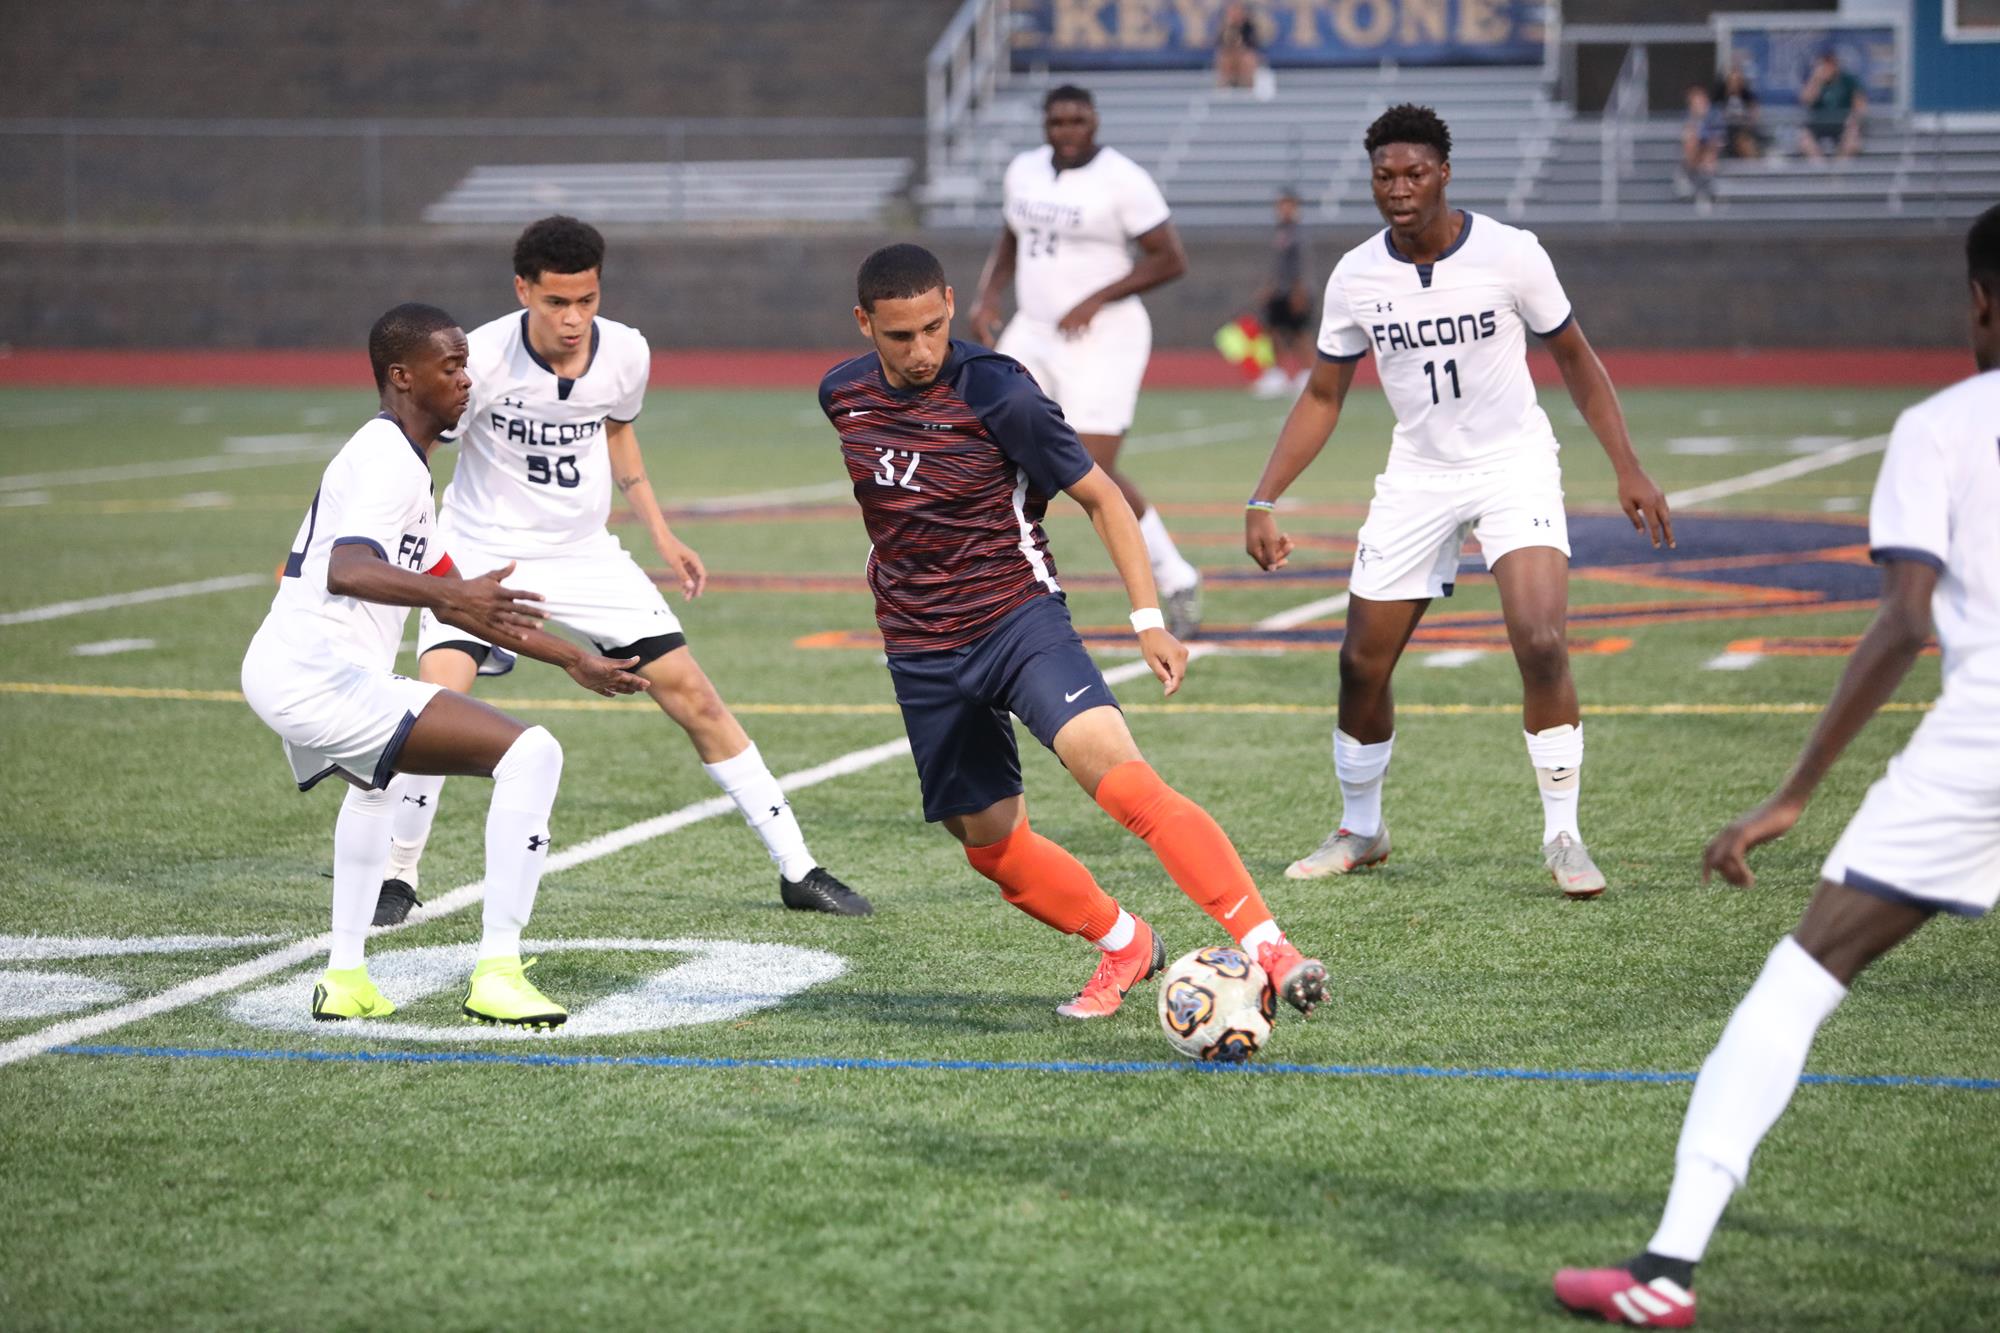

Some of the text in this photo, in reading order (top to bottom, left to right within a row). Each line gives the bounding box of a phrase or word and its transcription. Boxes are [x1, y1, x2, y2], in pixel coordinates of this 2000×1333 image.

[1372, 310, 1496, 352] FALCONS
[1423, 359, 1461, 405] 11
[873, 447, 921, 492] 32
[398, 533, 429, 572] FA
